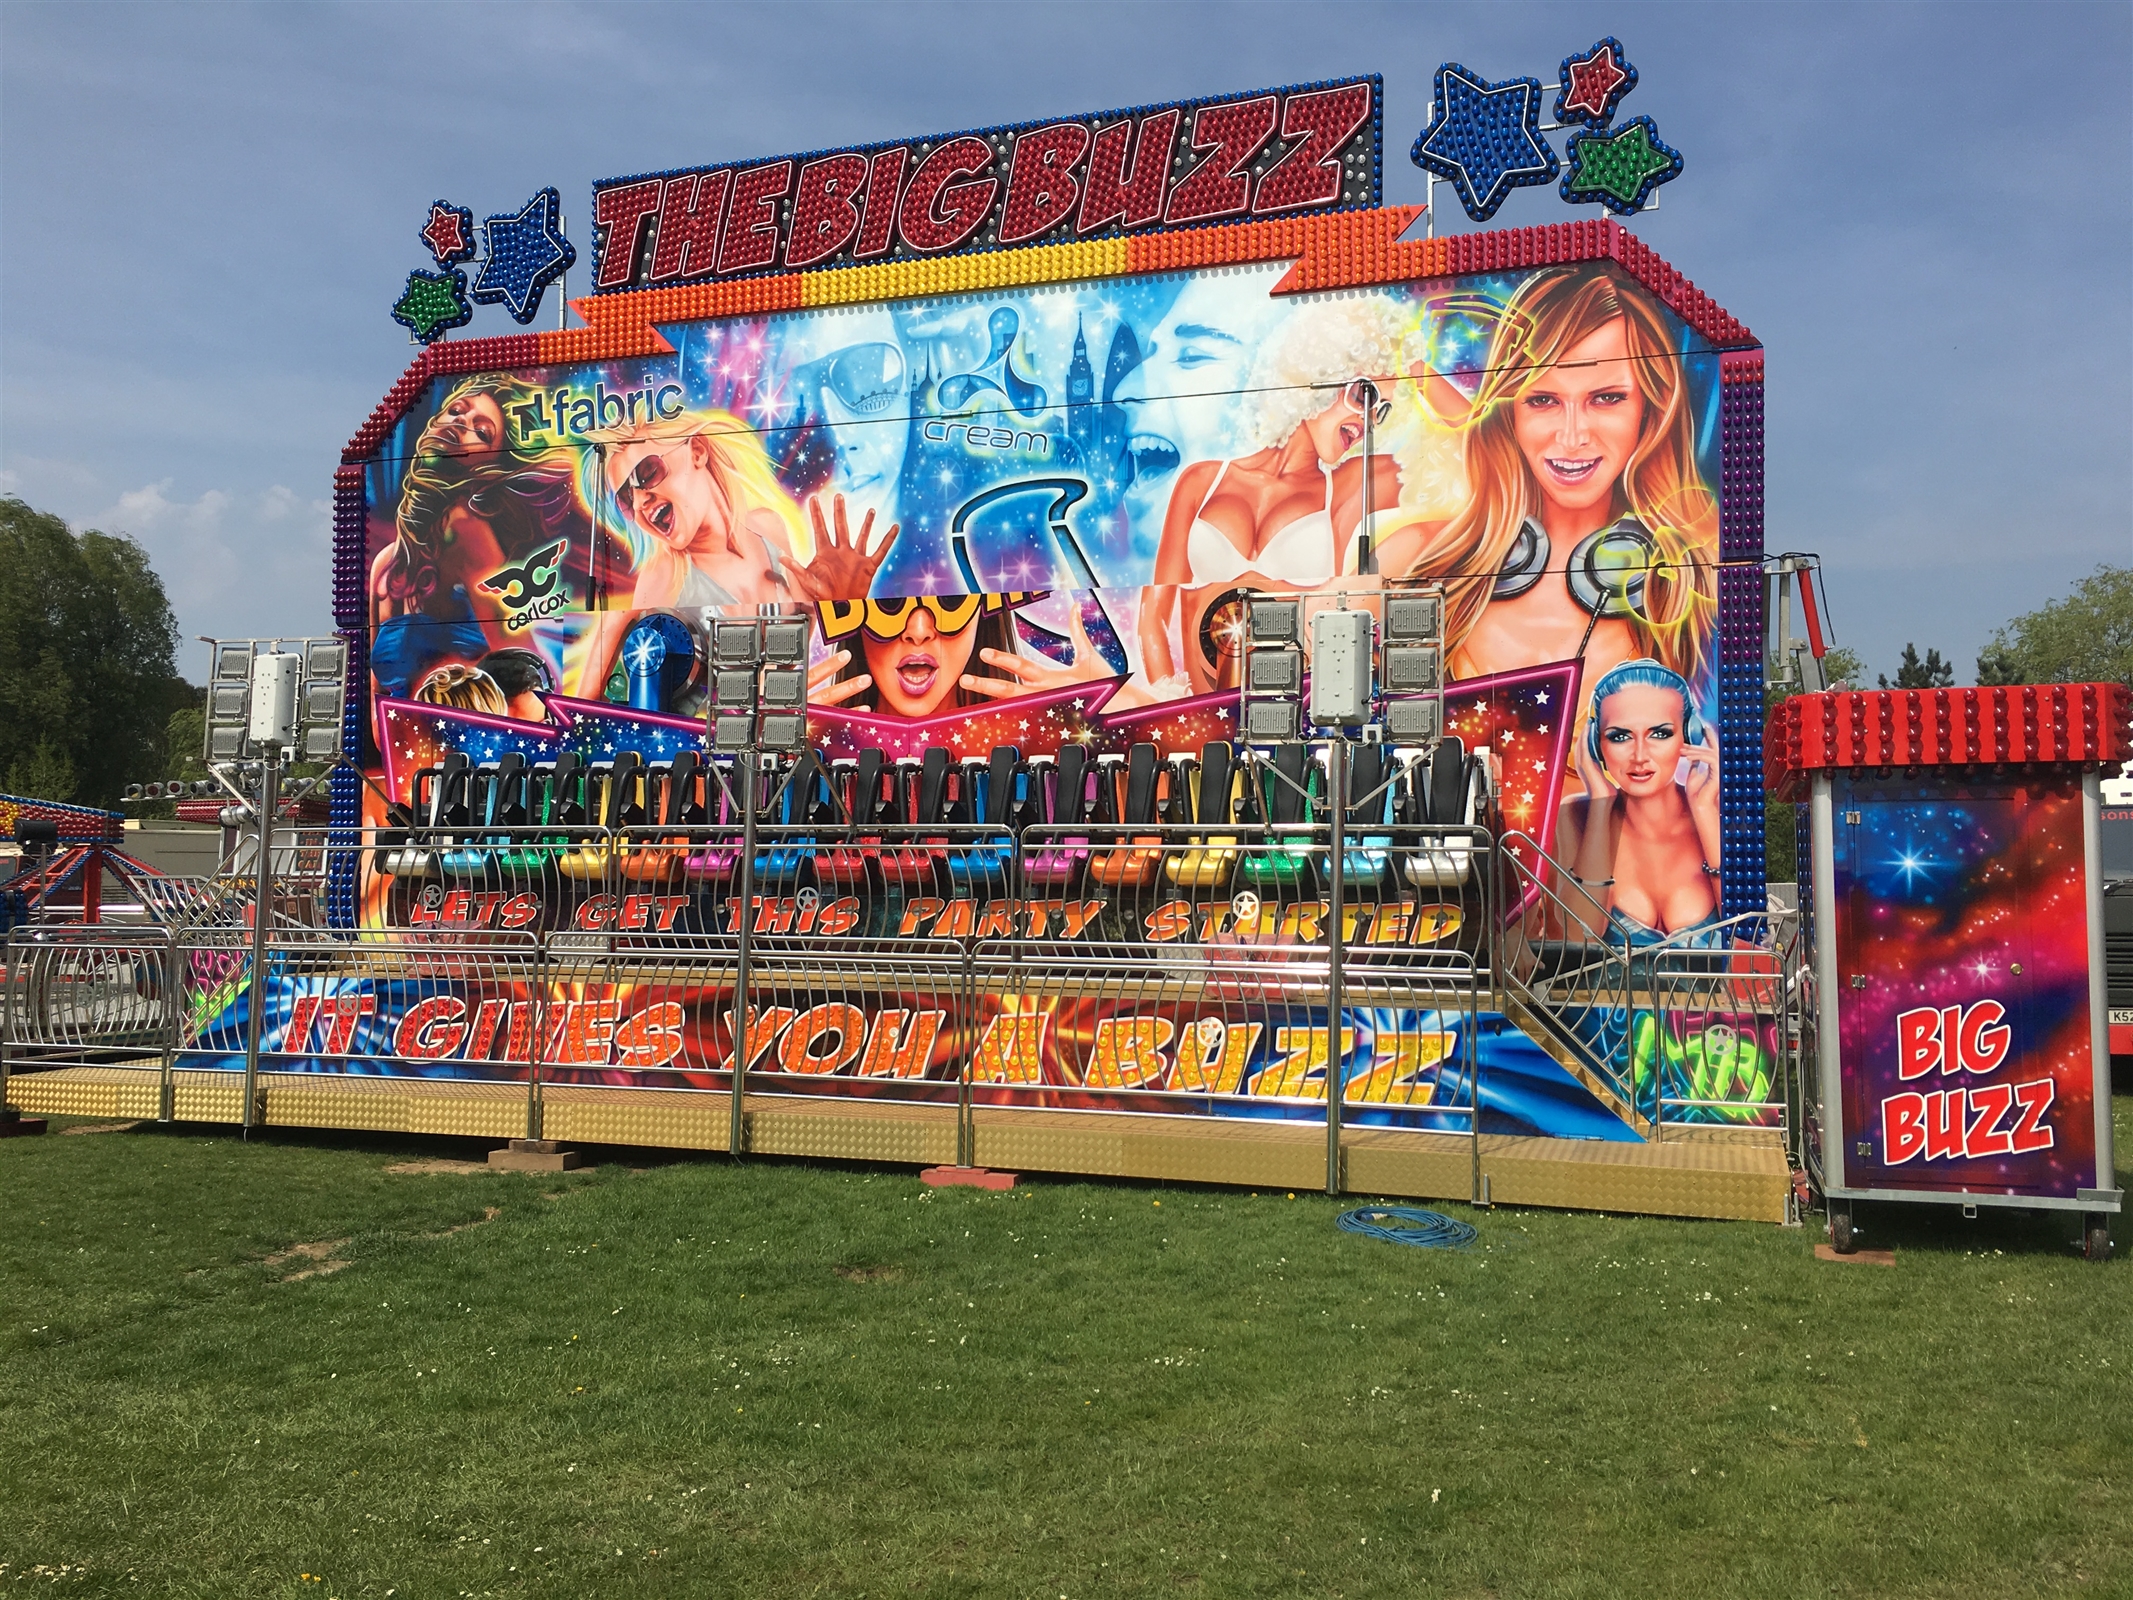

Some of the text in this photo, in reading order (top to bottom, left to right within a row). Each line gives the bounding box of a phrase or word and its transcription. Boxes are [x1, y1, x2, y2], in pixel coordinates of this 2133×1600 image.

[552, 374, 685, 436] fabric
[923, 420, 1048, 453] cream
[507, 588, 570, 631] carl cox
[410, 890, 1466, 944] LETS GET THIS PARTY STARTED
[280, 993, 1457, 1106] IT GIVES YOU A BUZZ
[1897, 999, 2011, 1080] BIG
[1881, 1078, 2054, 1165] BUZZ
